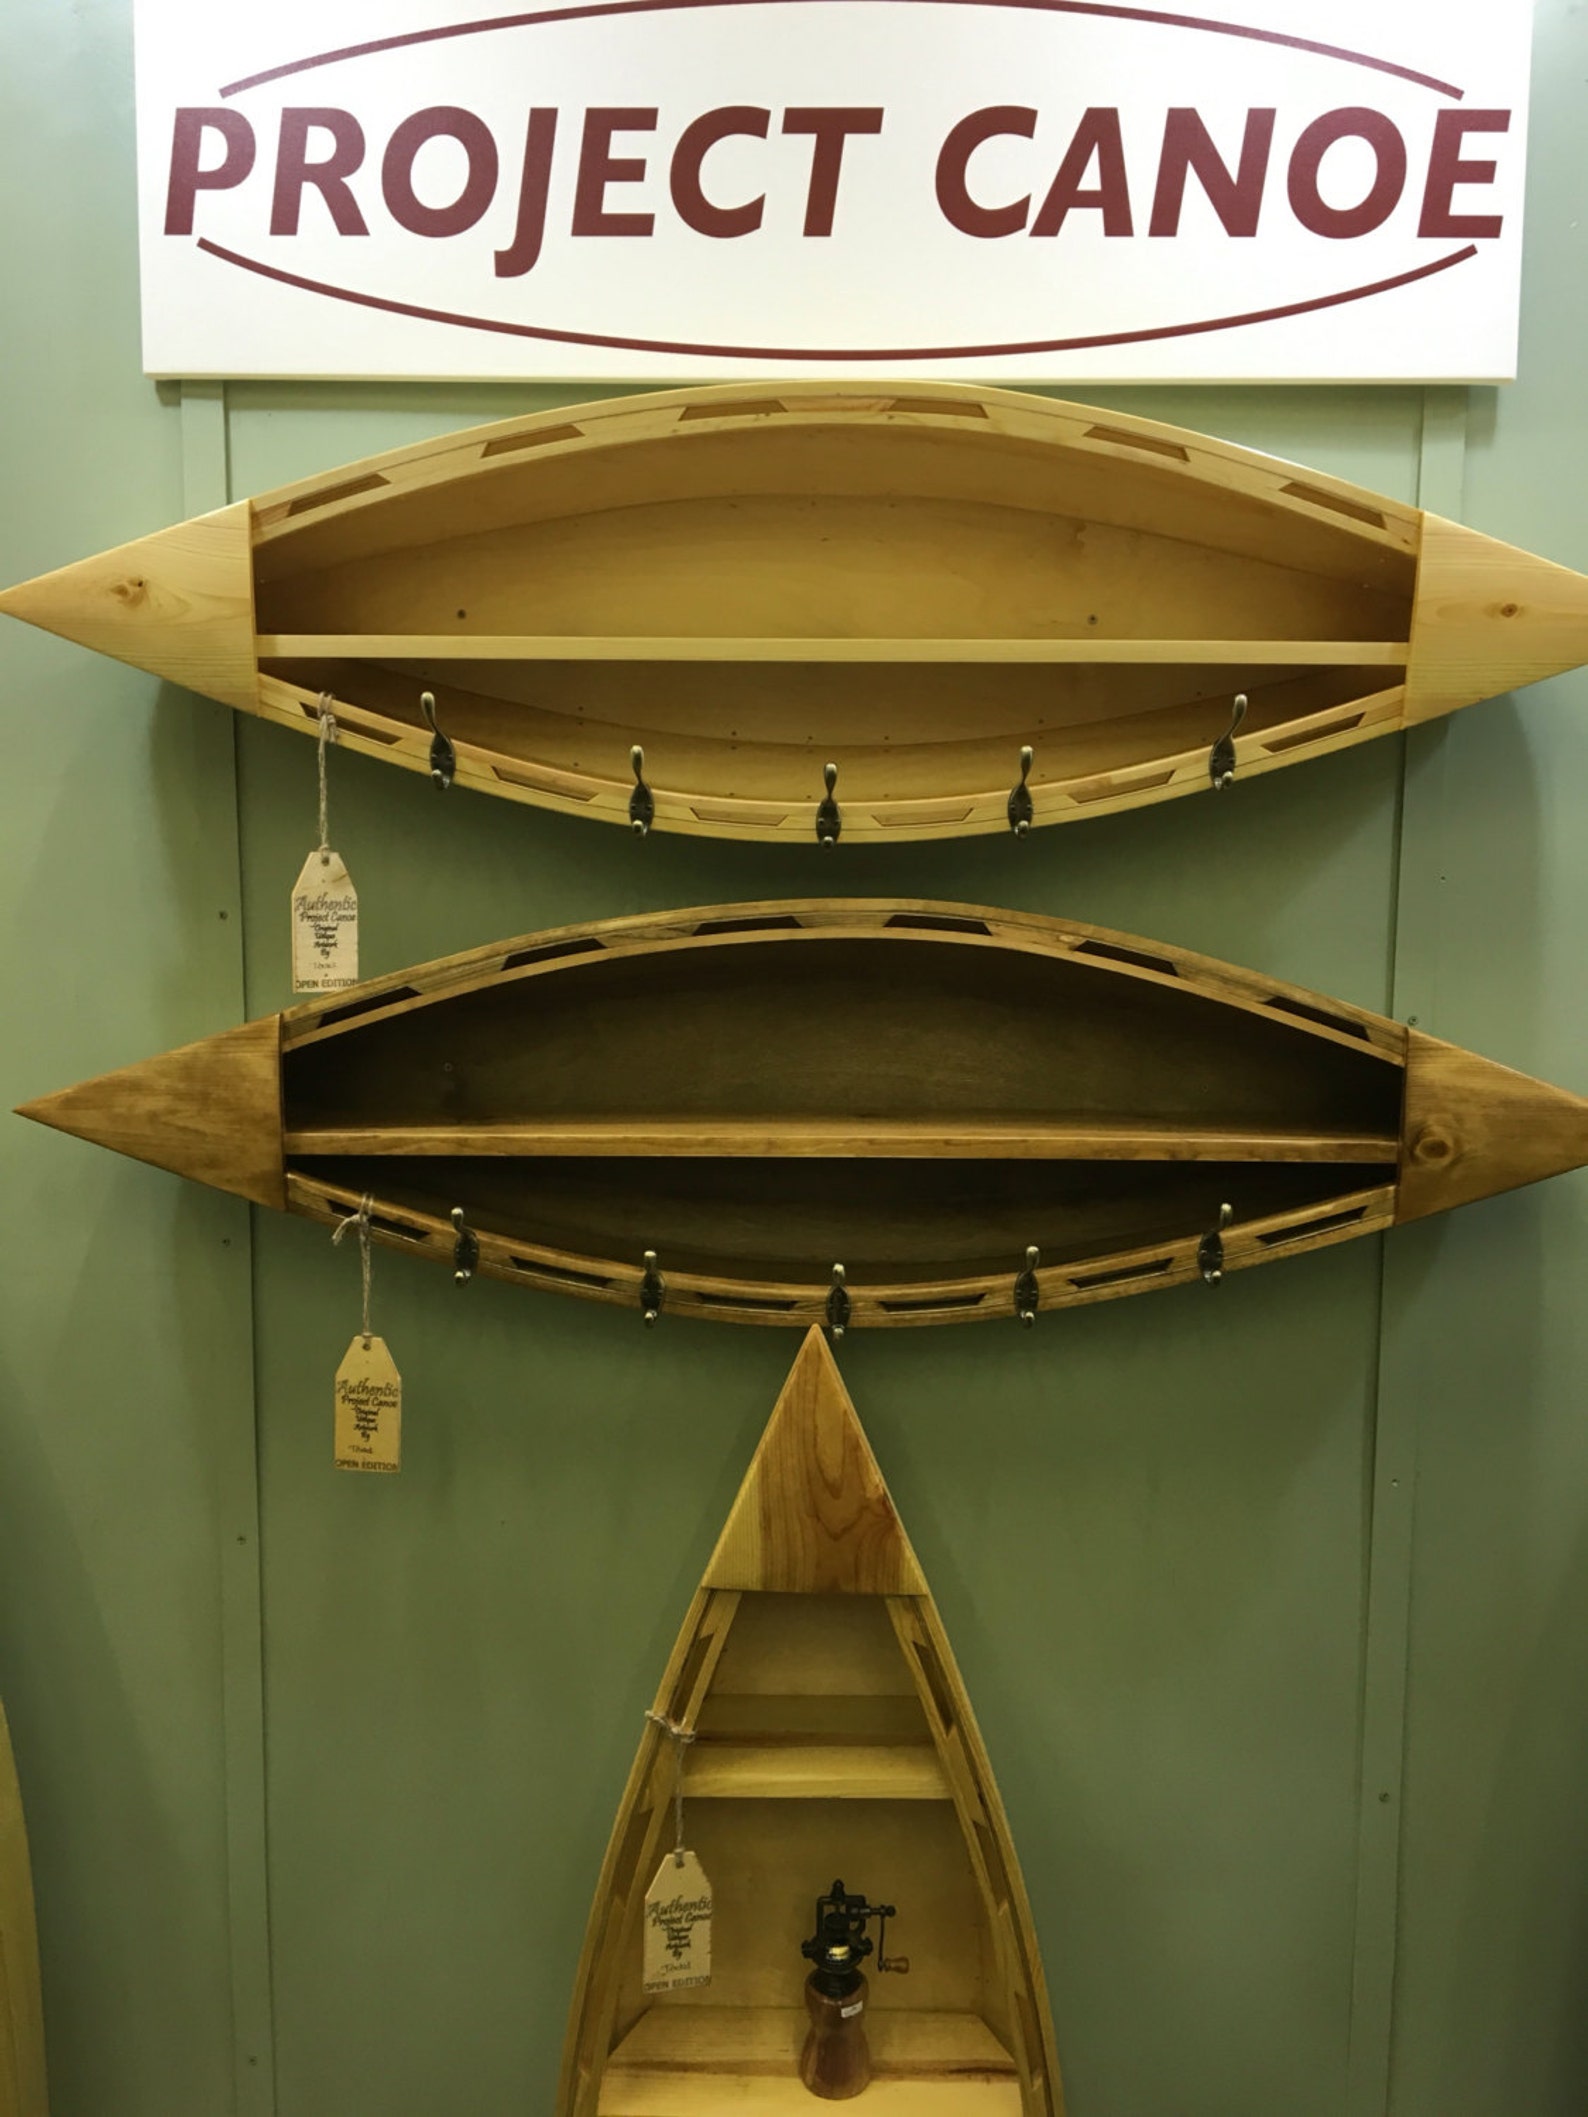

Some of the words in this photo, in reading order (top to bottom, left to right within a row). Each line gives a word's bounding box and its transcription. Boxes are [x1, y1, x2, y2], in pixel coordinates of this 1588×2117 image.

[164, 106, 883, 277] PROJECT
[935, 106, 1512, 239] CANOE
[295, 892, 357, 911] Authentic
[299, 911, 328, 922] Project
[330, 911, 356, 922] Canoe
[295, 980, 319, 989] OPEN
[321, 978, 357, 988] EDITION
[337, 1378, 399, 1398] Authentic
[341, 1395, 370, 1407] Project
[371, 1397, 398, 1408] Canoe
[336, 1459, 359, 1469] OPEN
[361, 1460, 399, 1470] EDITION
[647, 1895, 712, 1916] Authentic
[652, 1915, 684, 1927] Project
[645, 1980, 669, 1991] OPEN
[672, 1975, 712, 1988] EDITION
